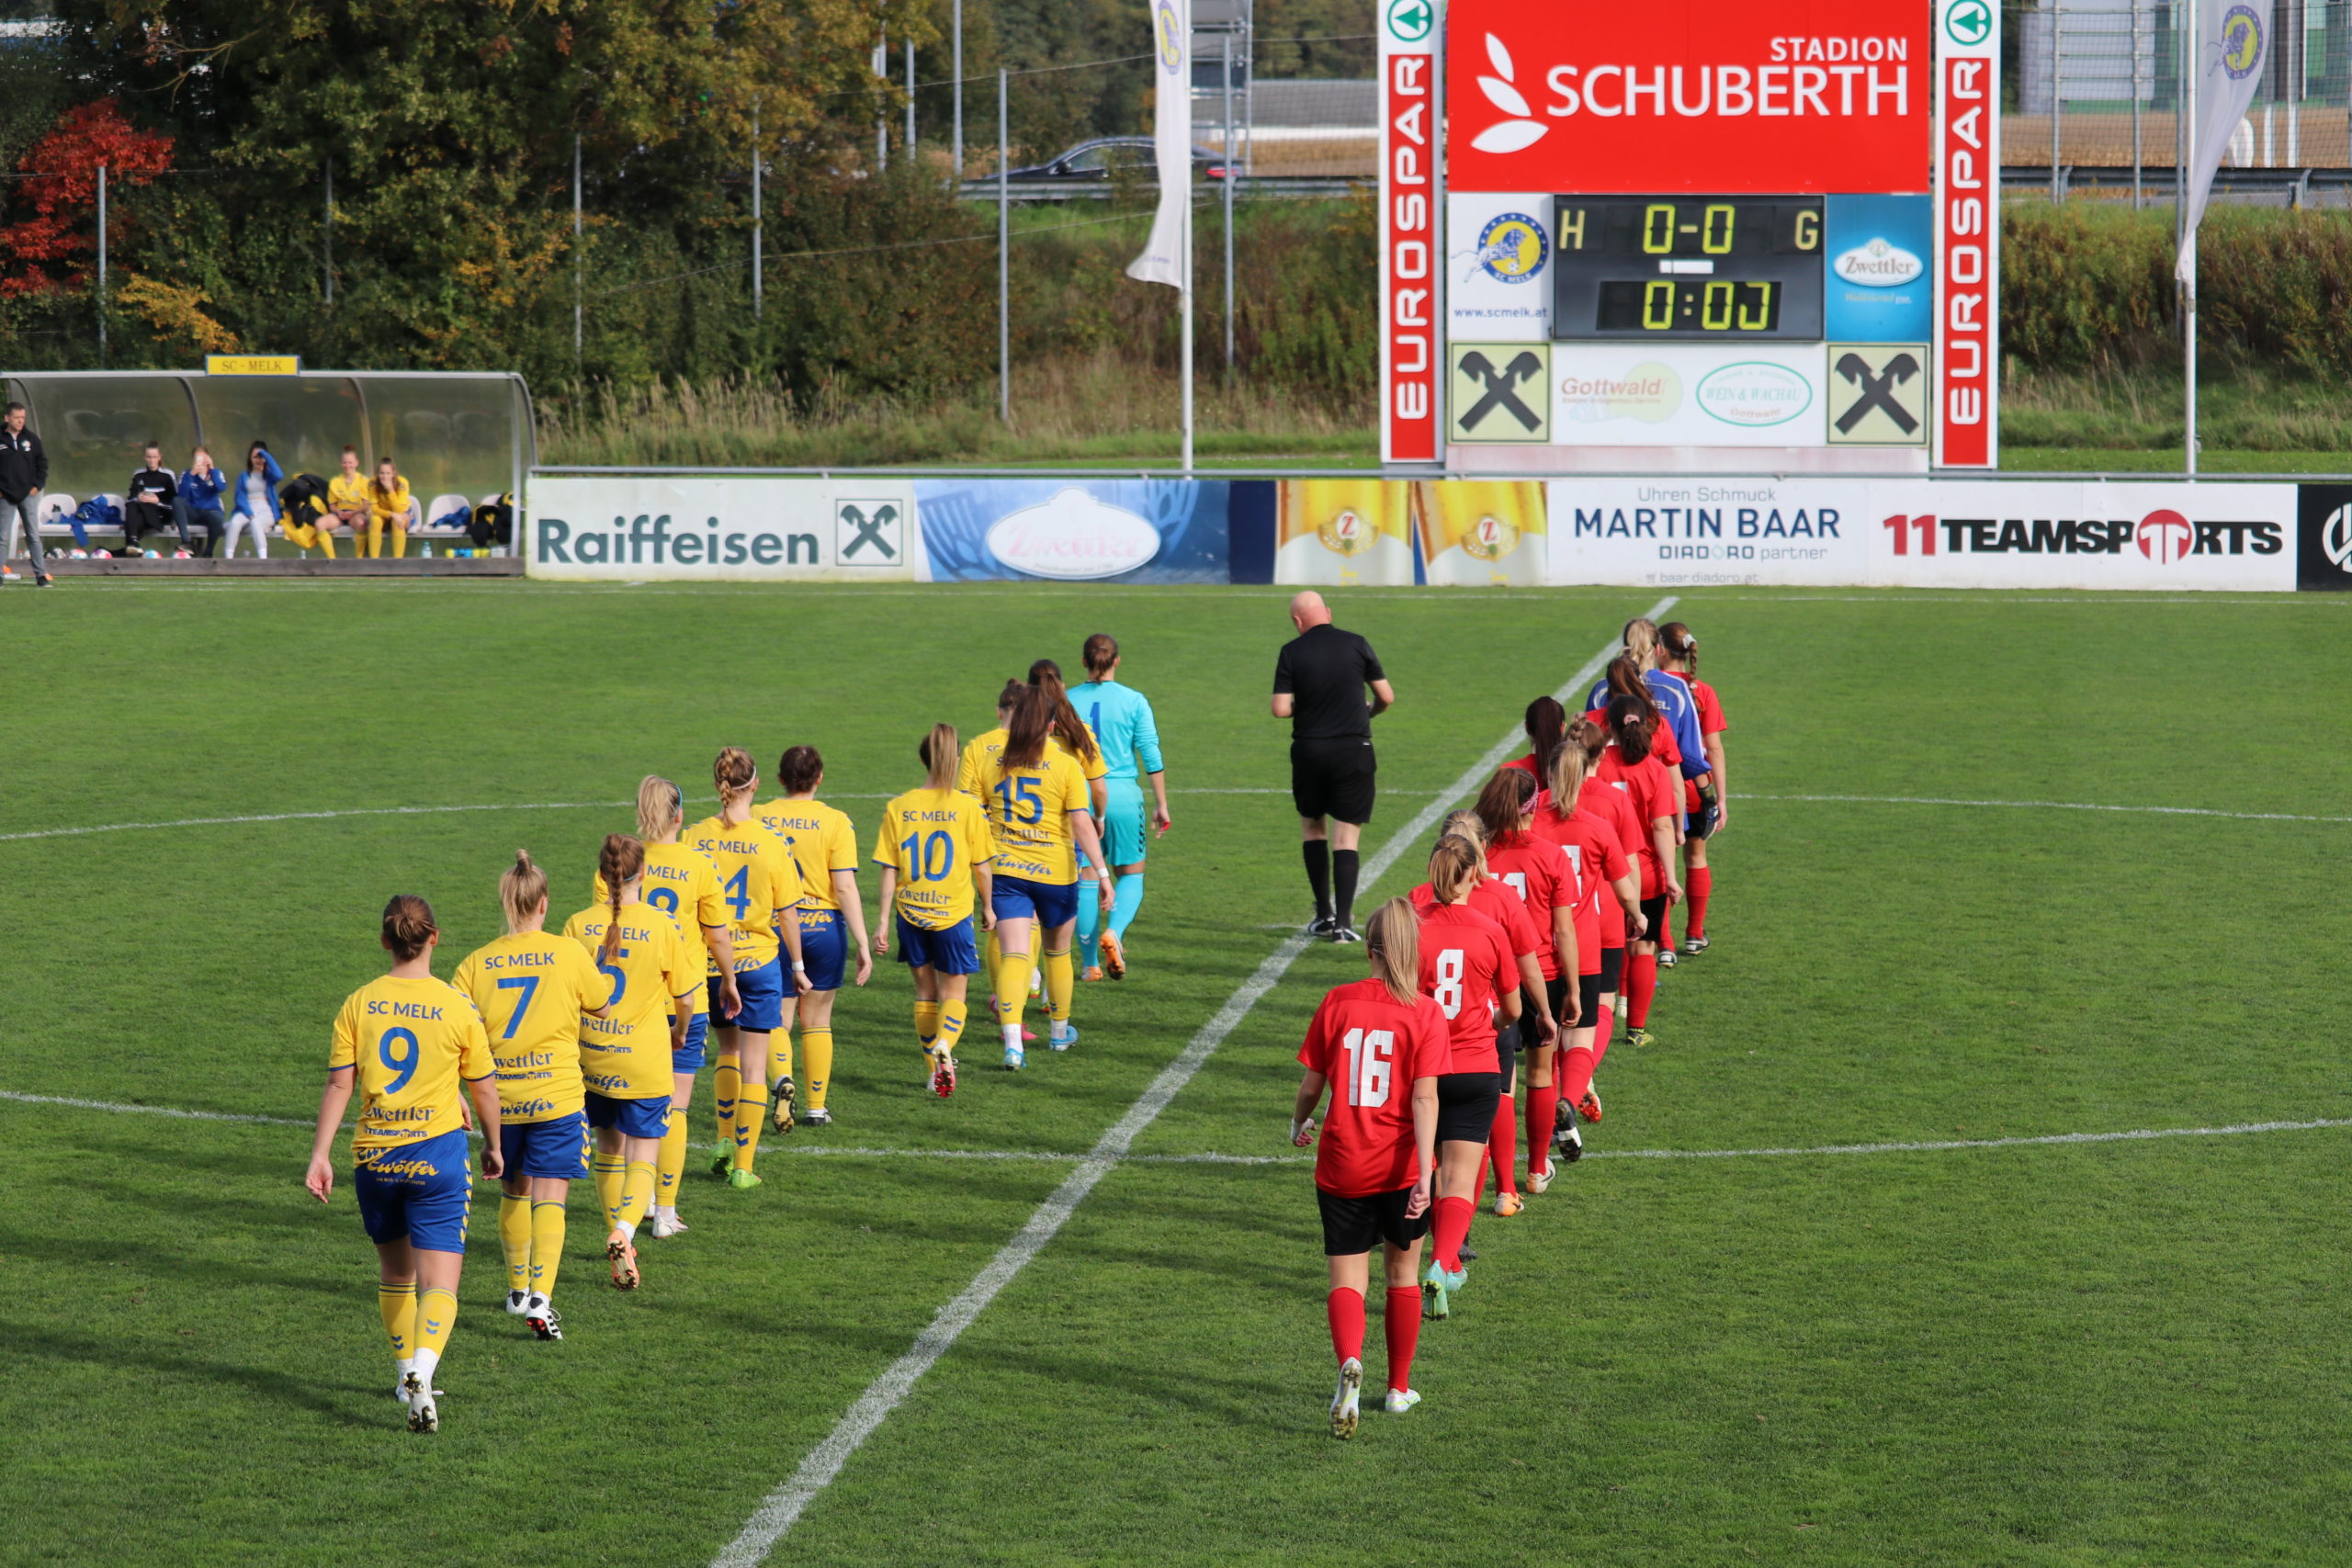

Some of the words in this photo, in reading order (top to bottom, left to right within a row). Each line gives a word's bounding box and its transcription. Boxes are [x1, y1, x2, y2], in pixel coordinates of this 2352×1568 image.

[1770, 38, 1908, 62] STADION
[1546, 64, 1908, 117] SCHUBERTH
[1395, 57, 1428, 420] EUROSPAR
[1559, 209, 1586, 250] H
[1794, 210, 1819, 251] G
[1950, 61, 1983, 425] EUROSPAR
[1845, 256, 1915, 275] Zwettler
[1454, 307, 1548, 319] www.scmelk.at
[221, 360, 237, 373] SC
[248, 360, 282, 373] MELK
[1561, 377, 1662, 396] Gottwald
[1706, 388, 1736, 401] WEIN
[1638, 486, 1690, 502] Uhren
[1698, 486, 1776, 502] Schmuck
[1574, 508, 1722, 538] MARTIN
[1737, 508, 1841, 538] BAAR
[537, 514, 820, 565] Raiffeisen
[1760, 547, 1828, 563] partner
[994, 774, 1044, 825] 15
[762, 816, 777, 828] SC
[781, 818, 820, 830] MELK
[902, 810, 917, 822] SC
[922, 810, 957, 822] MELK
[698, 839, 715, 852] SC
[718, 840, 759, 855] MELK
[900, 830, 954, 882] 10
[647, 864, 689, 883] MELK
[724, 864, 752, 920] 4
[584, 924, 603, 936] SC
[484, 955, 503, 970] SC
[508, 952, 556, 967] MELK
[1434, 949, 1464, 1021] 8
[368, 1000, 389, 1015] SC
[393, 1001, 444, 1021] MELK
[497, 976, 539, 1039] 7
[581, 1016, 635, 1035] wettler
[379, 1026, 420, 1095] 9
[492, 1050, 553, 1068] wettler
[1343, 1027, 1395, 1108] 16
[501, 1098, 556, 1118] wölfer
